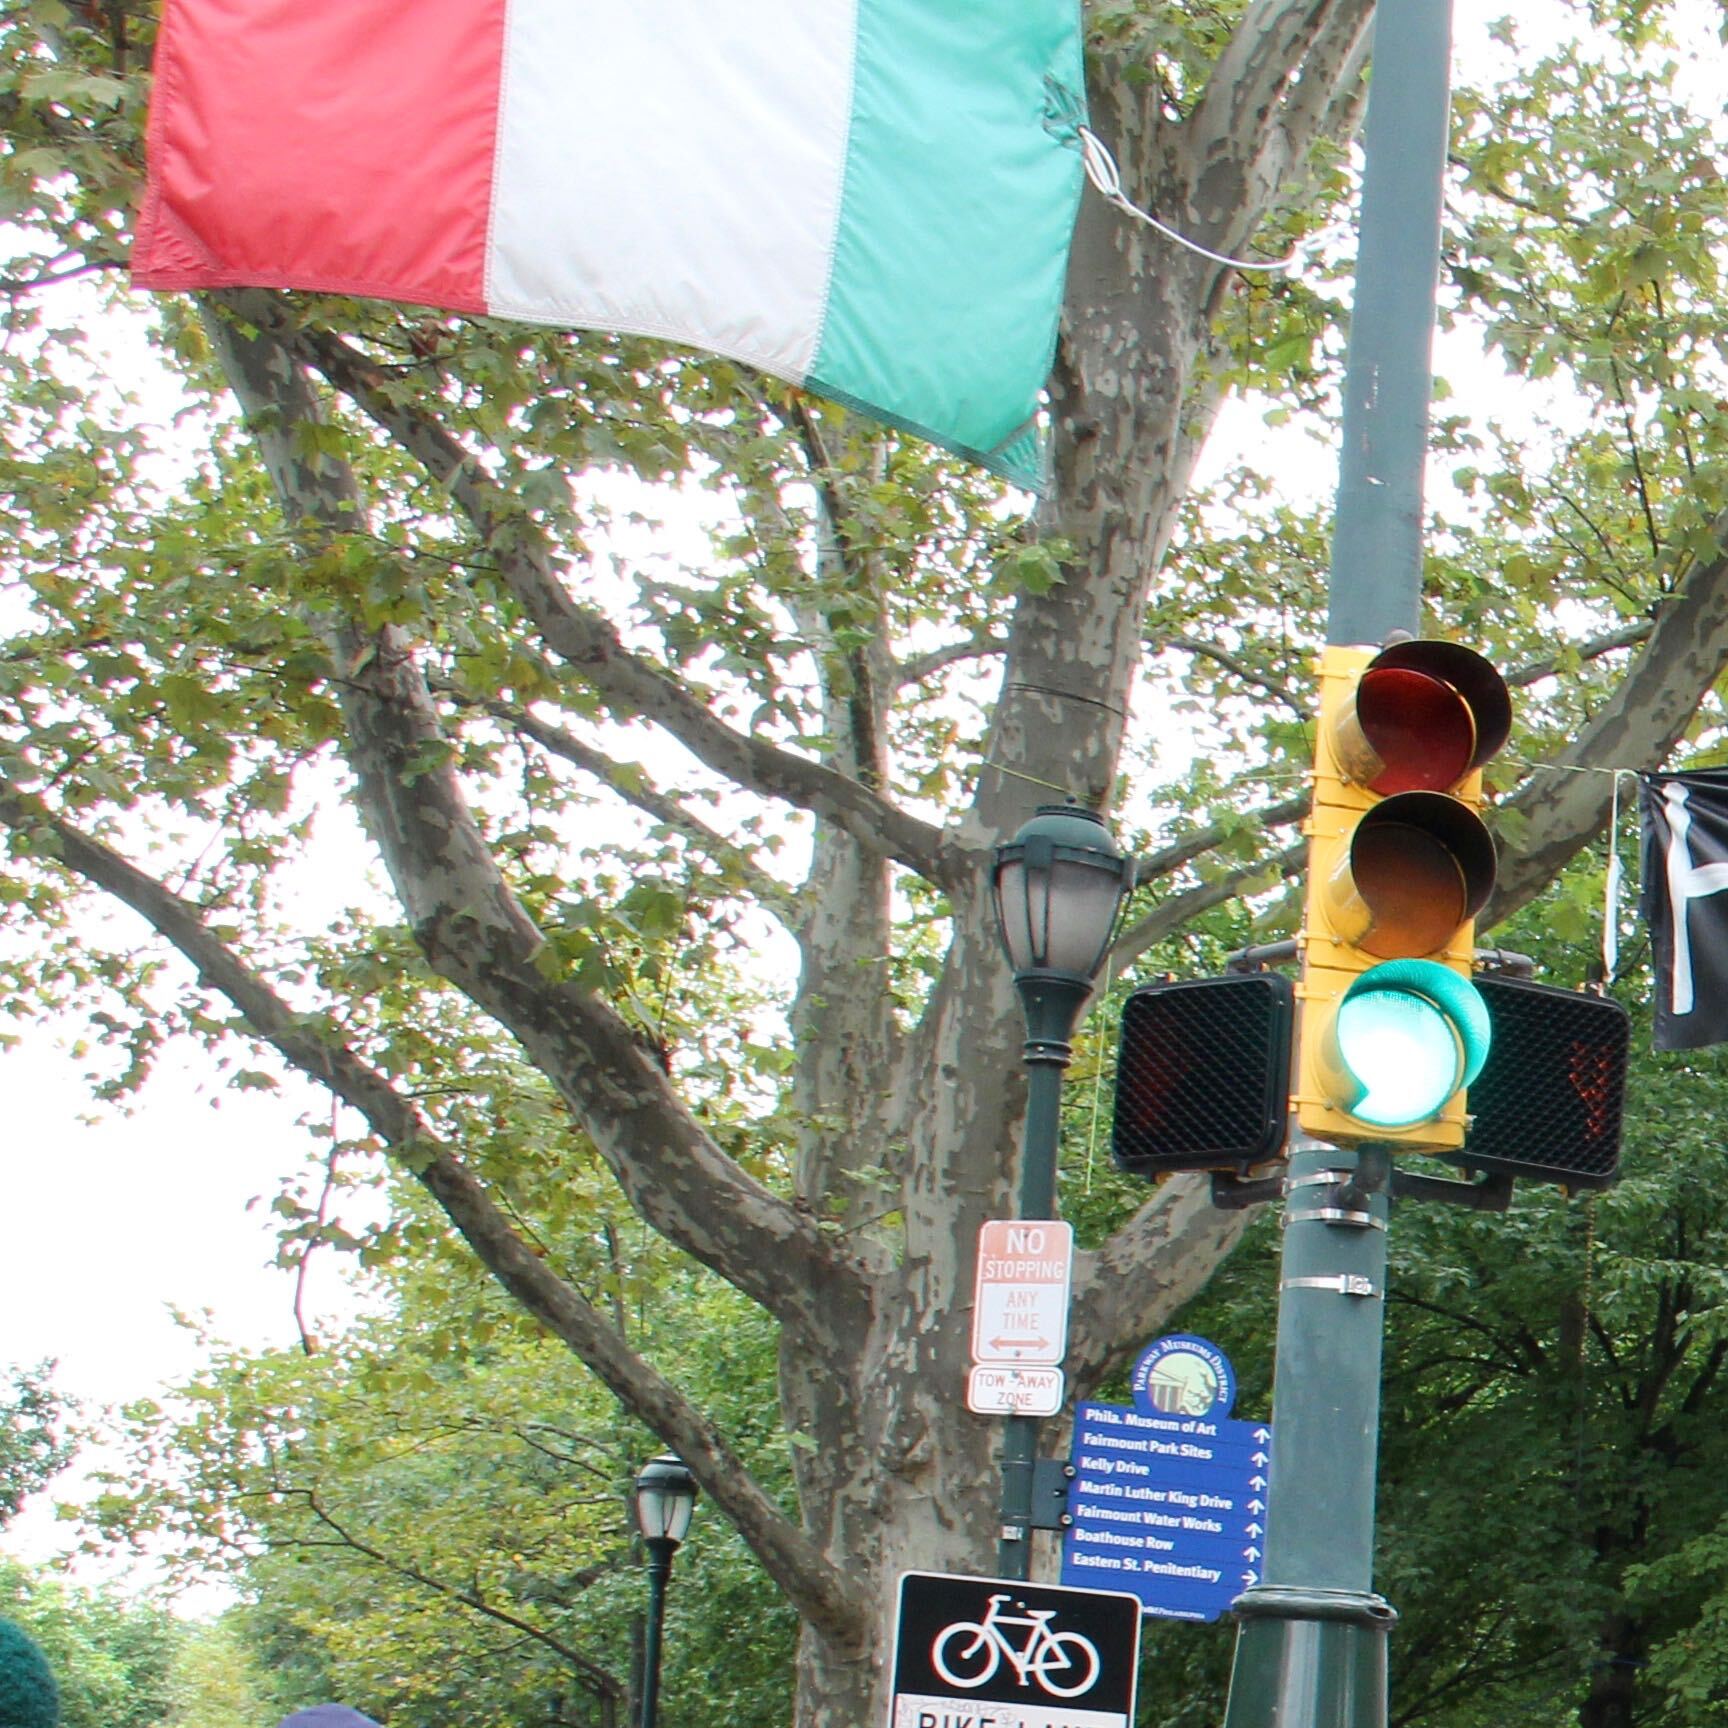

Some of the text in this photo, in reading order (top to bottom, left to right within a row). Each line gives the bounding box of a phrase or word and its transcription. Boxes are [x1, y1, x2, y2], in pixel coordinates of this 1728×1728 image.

[1007, 1228, 1045, 1255] NO
[986, 1260, 1064, 1279] STOPPING
[1006, 1290, 1039, 1308] ANY
[1002, 1313, 1040, 1330] TIME
[997, 1391, 1033, 1406] ZONE
[1085, 1408, 1217, 1437] Phila. Museum of Art
[1083, 1432, 1213, 1460] Fairmount Park Sites
[1081, 1456, 1150, 1476] Kelly Drive
[1079, 1480, 1233, 1510] Martin Luther King Drive
[1077, 1504, 1222, 1533] Fairmount Water Works
[1074, 1528, 1174, 1551] Boathouse Row
[1072, 1552, 1222, 1584] Eastern St. Penitentiary
